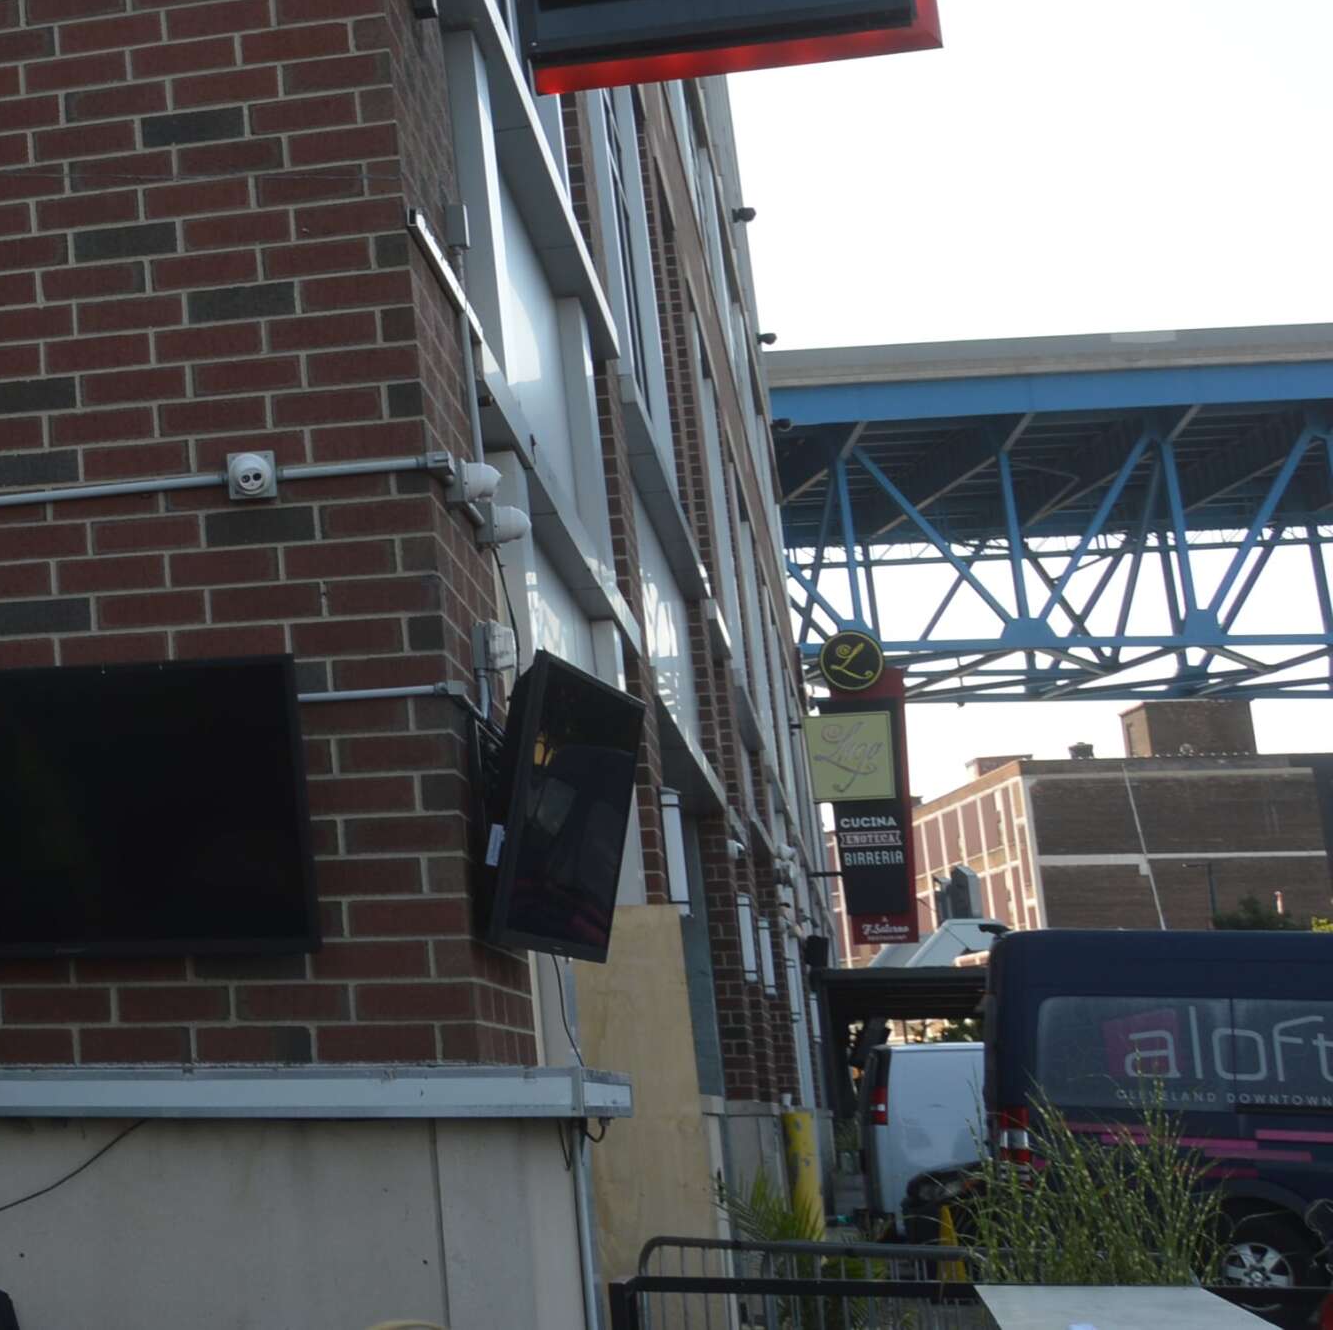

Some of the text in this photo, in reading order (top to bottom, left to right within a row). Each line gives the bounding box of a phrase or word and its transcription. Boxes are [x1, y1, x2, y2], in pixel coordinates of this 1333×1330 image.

[840, 816, 897, 829] CUCINA
[846, 833, 896, 845] ENOTECA
[844, 850, 905, 867] BIRRERIA
[1124, 1005, 1333, 1083] aloft
[1115, 1089, 1333, 1107] CLEVELAND DOWNTOWN
